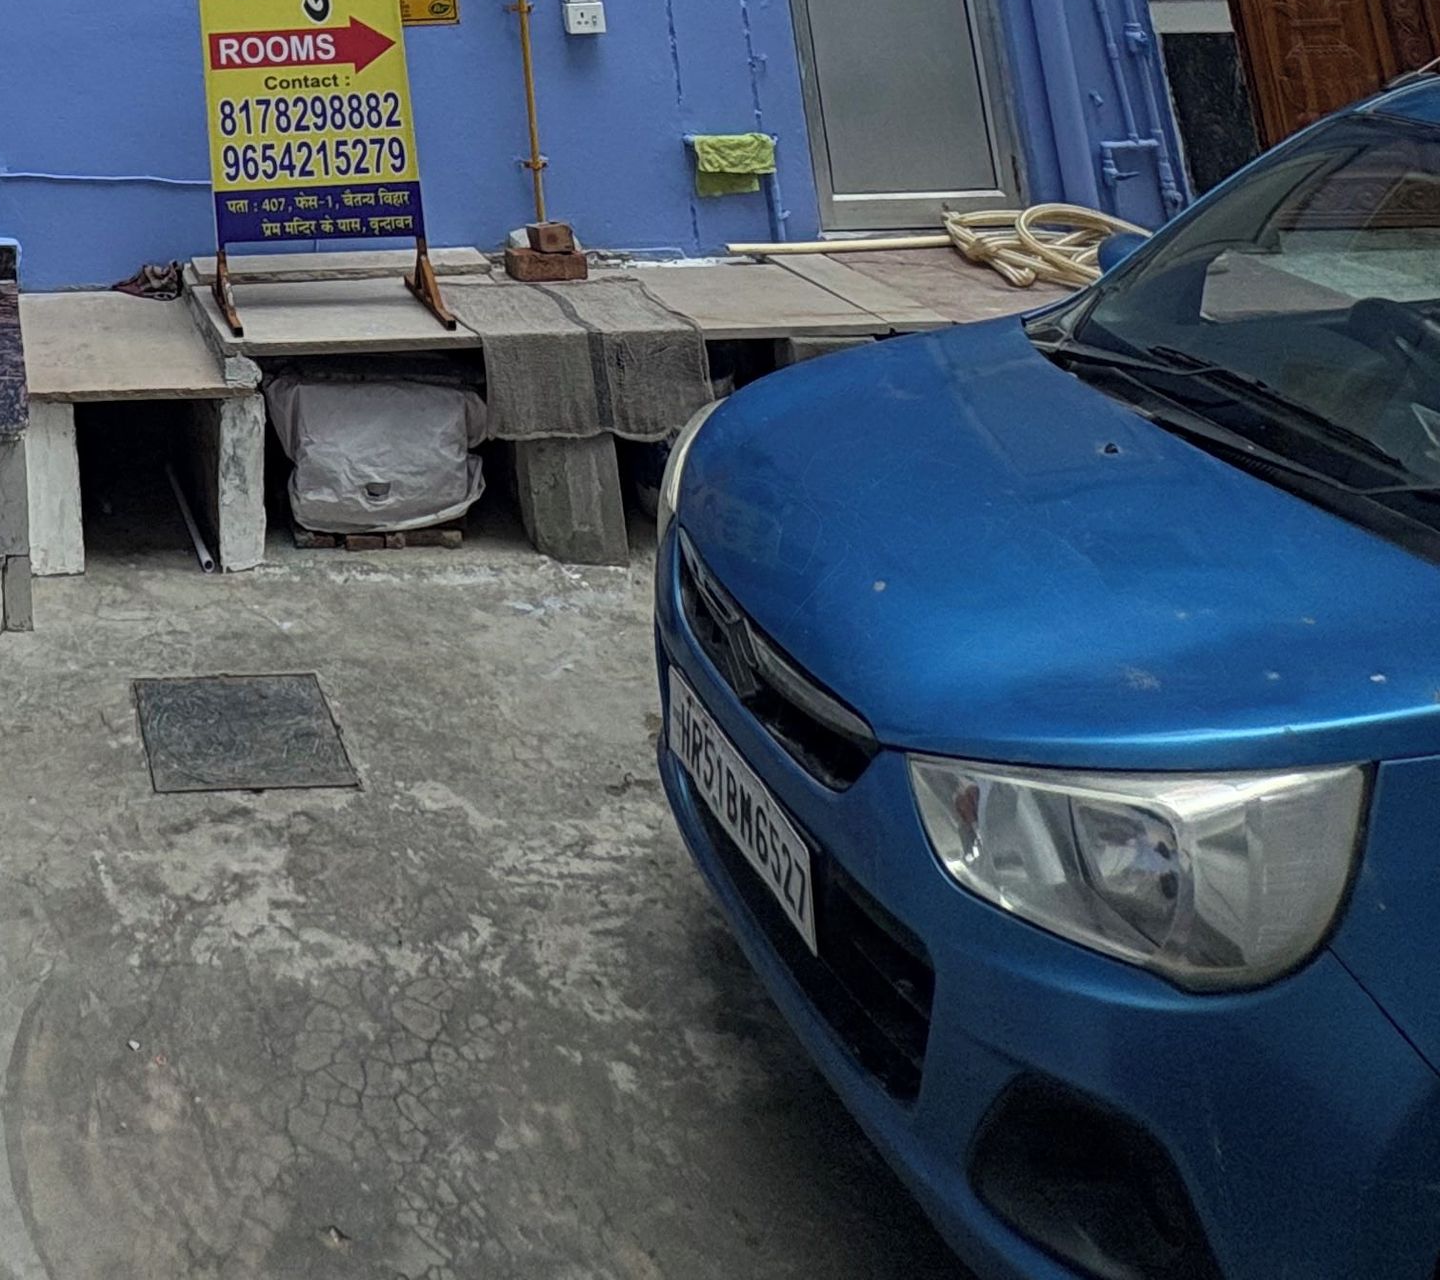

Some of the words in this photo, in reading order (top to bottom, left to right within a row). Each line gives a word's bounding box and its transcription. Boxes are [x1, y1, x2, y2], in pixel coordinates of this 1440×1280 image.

[218, 33, 336, 65] ROOMS
[264, 74, 340, 91] Contact
[219, 91, 402, 137] 8178298882
[222, 136, 406, 183] 9654215279
[225, 199, 249, 214] पता
[377, 186, 410, 207] विहार
[319, 214, 335, 234] के
